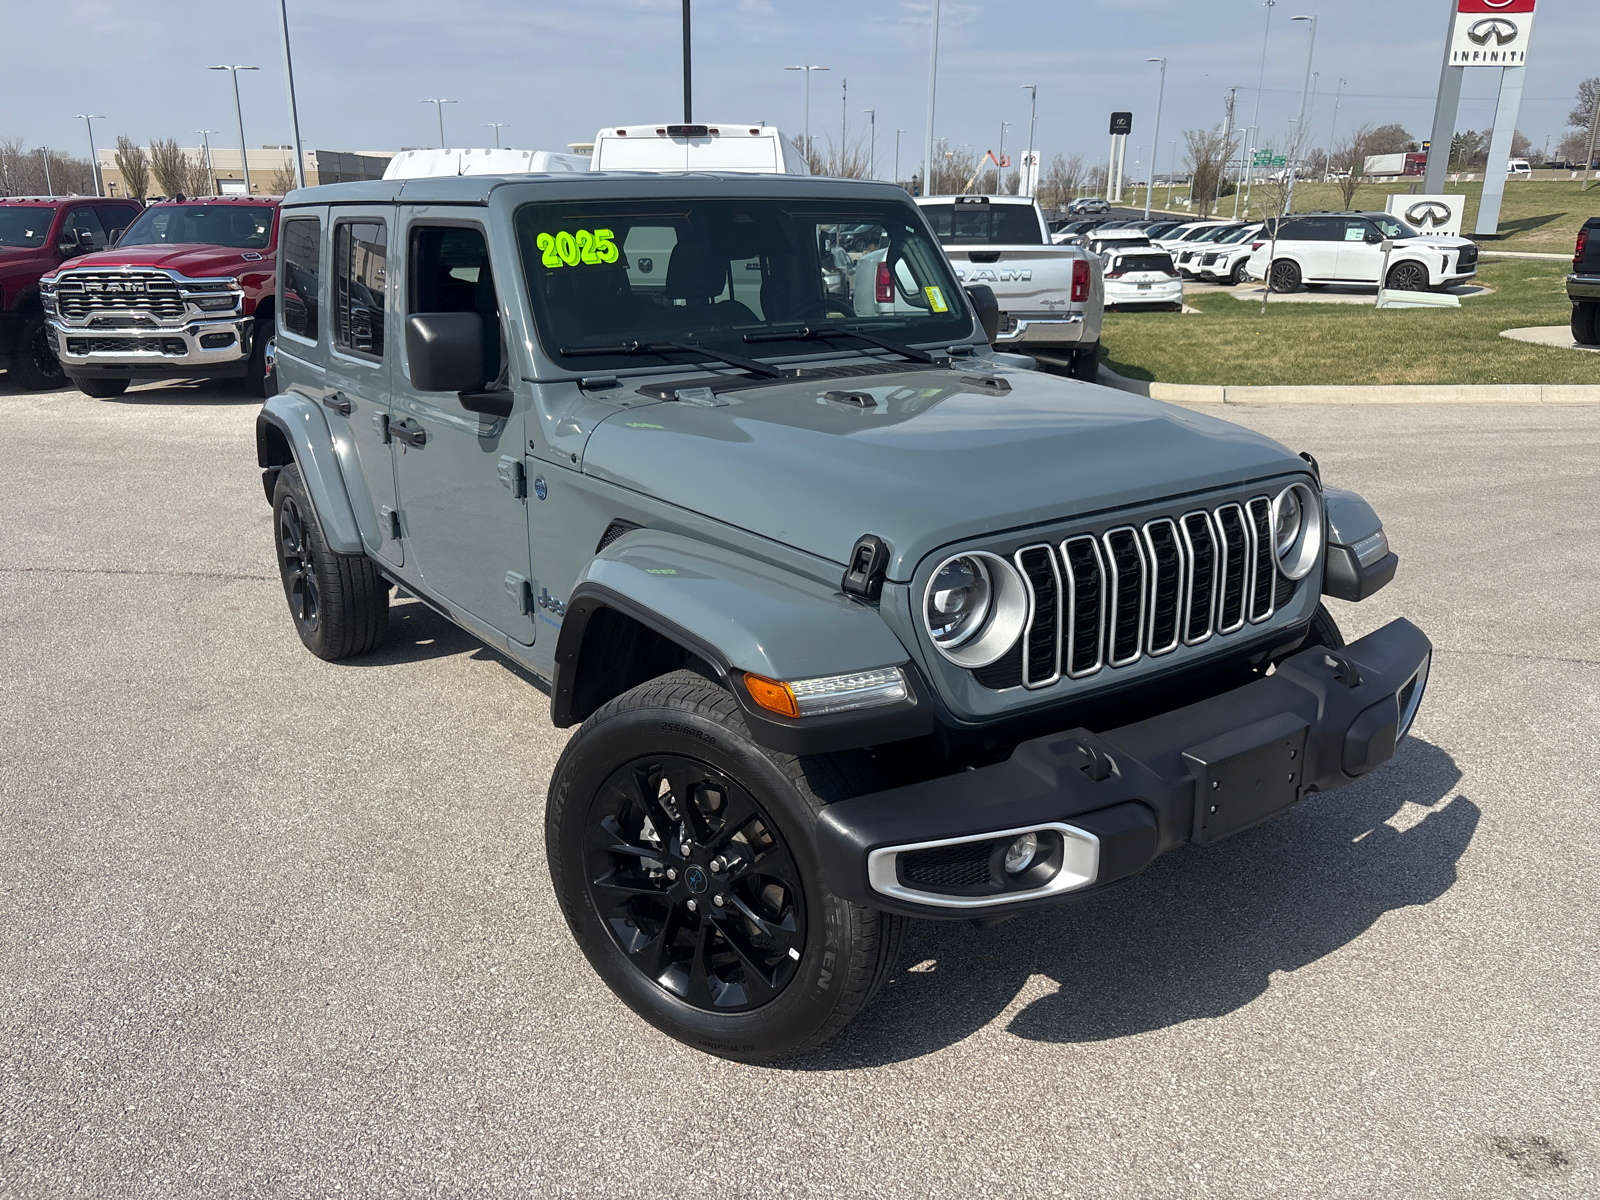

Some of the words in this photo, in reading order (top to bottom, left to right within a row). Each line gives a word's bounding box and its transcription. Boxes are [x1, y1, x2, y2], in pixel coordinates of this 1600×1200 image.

[1453, 51, 1525, 62] INFINITI
[536, 229, 619, 268] 2025
[84, 282, 145, 294] RAM
[537, 587, 567, 618] Jee
[661, 721, 717, 745] 255/60R20
